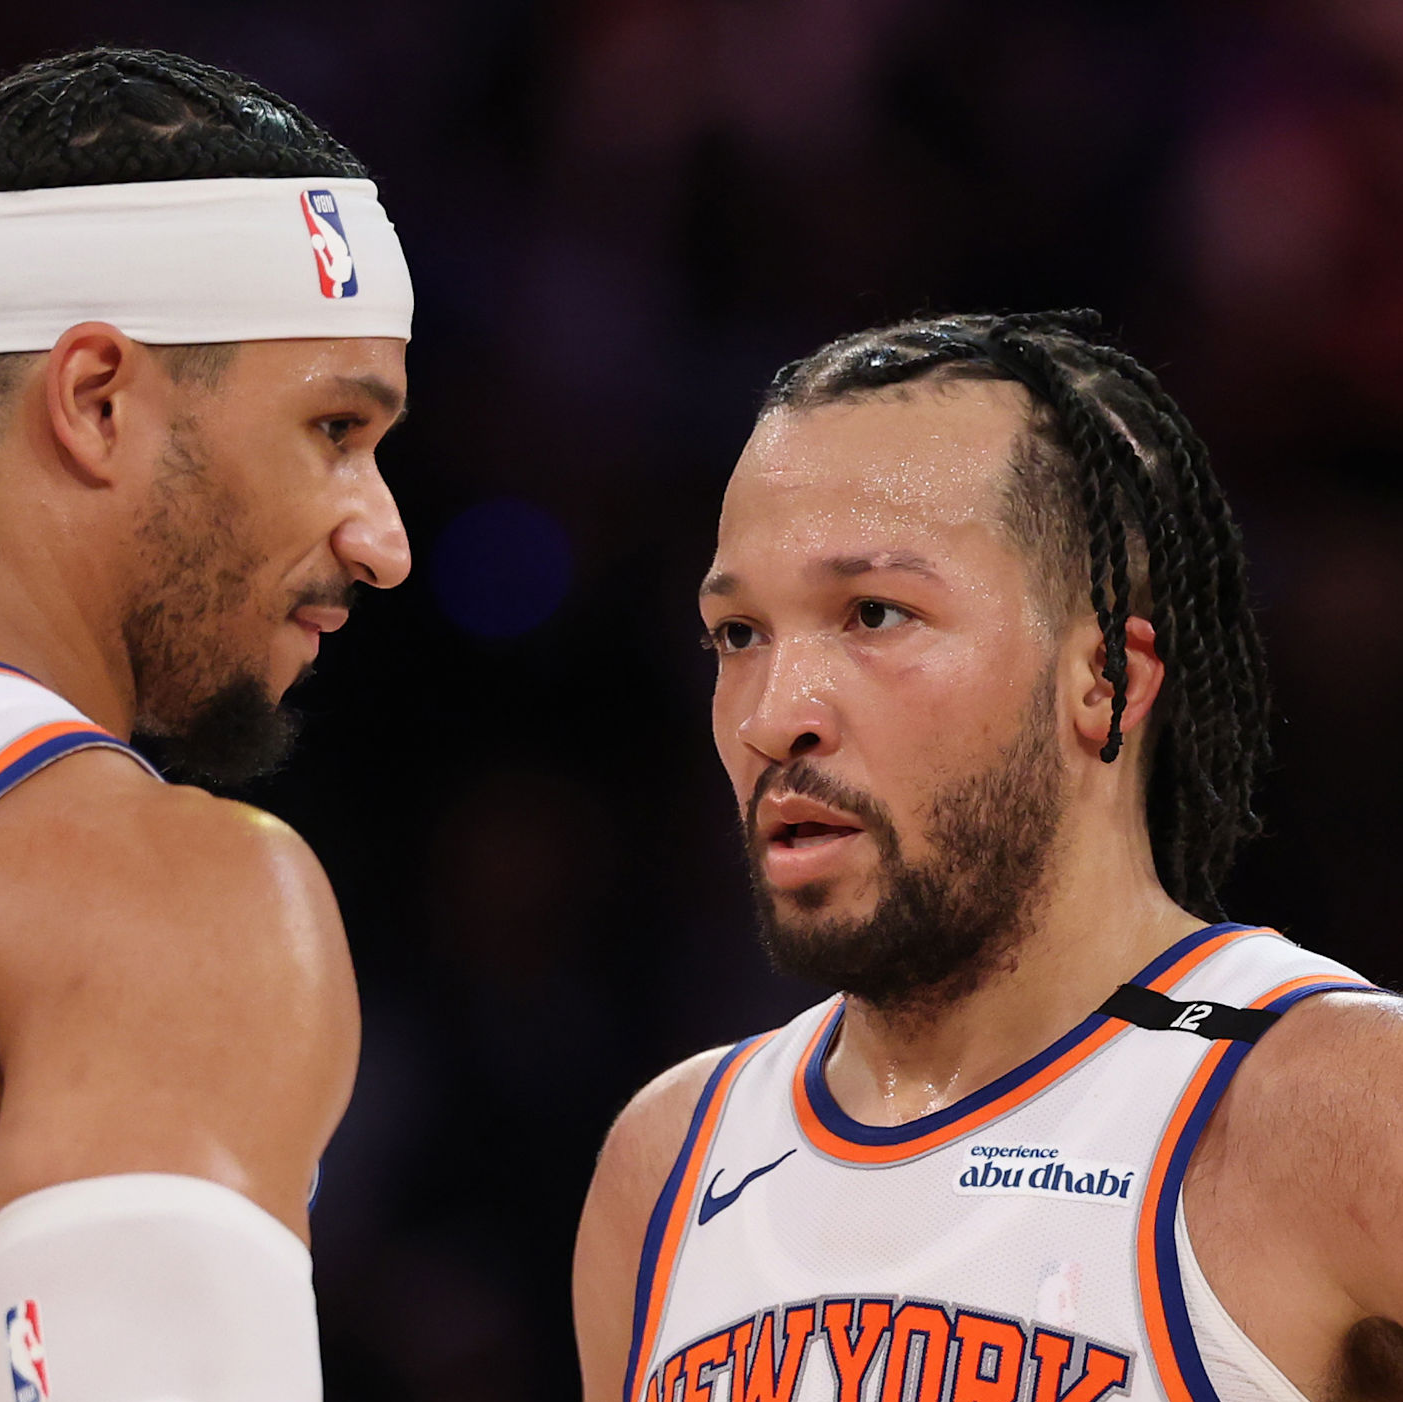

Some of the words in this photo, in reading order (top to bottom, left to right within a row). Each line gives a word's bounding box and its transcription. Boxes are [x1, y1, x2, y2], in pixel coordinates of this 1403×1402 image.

[1170, 1003, 1213, 1031] 12
[971, 1145, 1059, 1159] experience
[959, 1161, 1024, 1188] abu
[1028, 1162, 1135, 1199] dhabi
